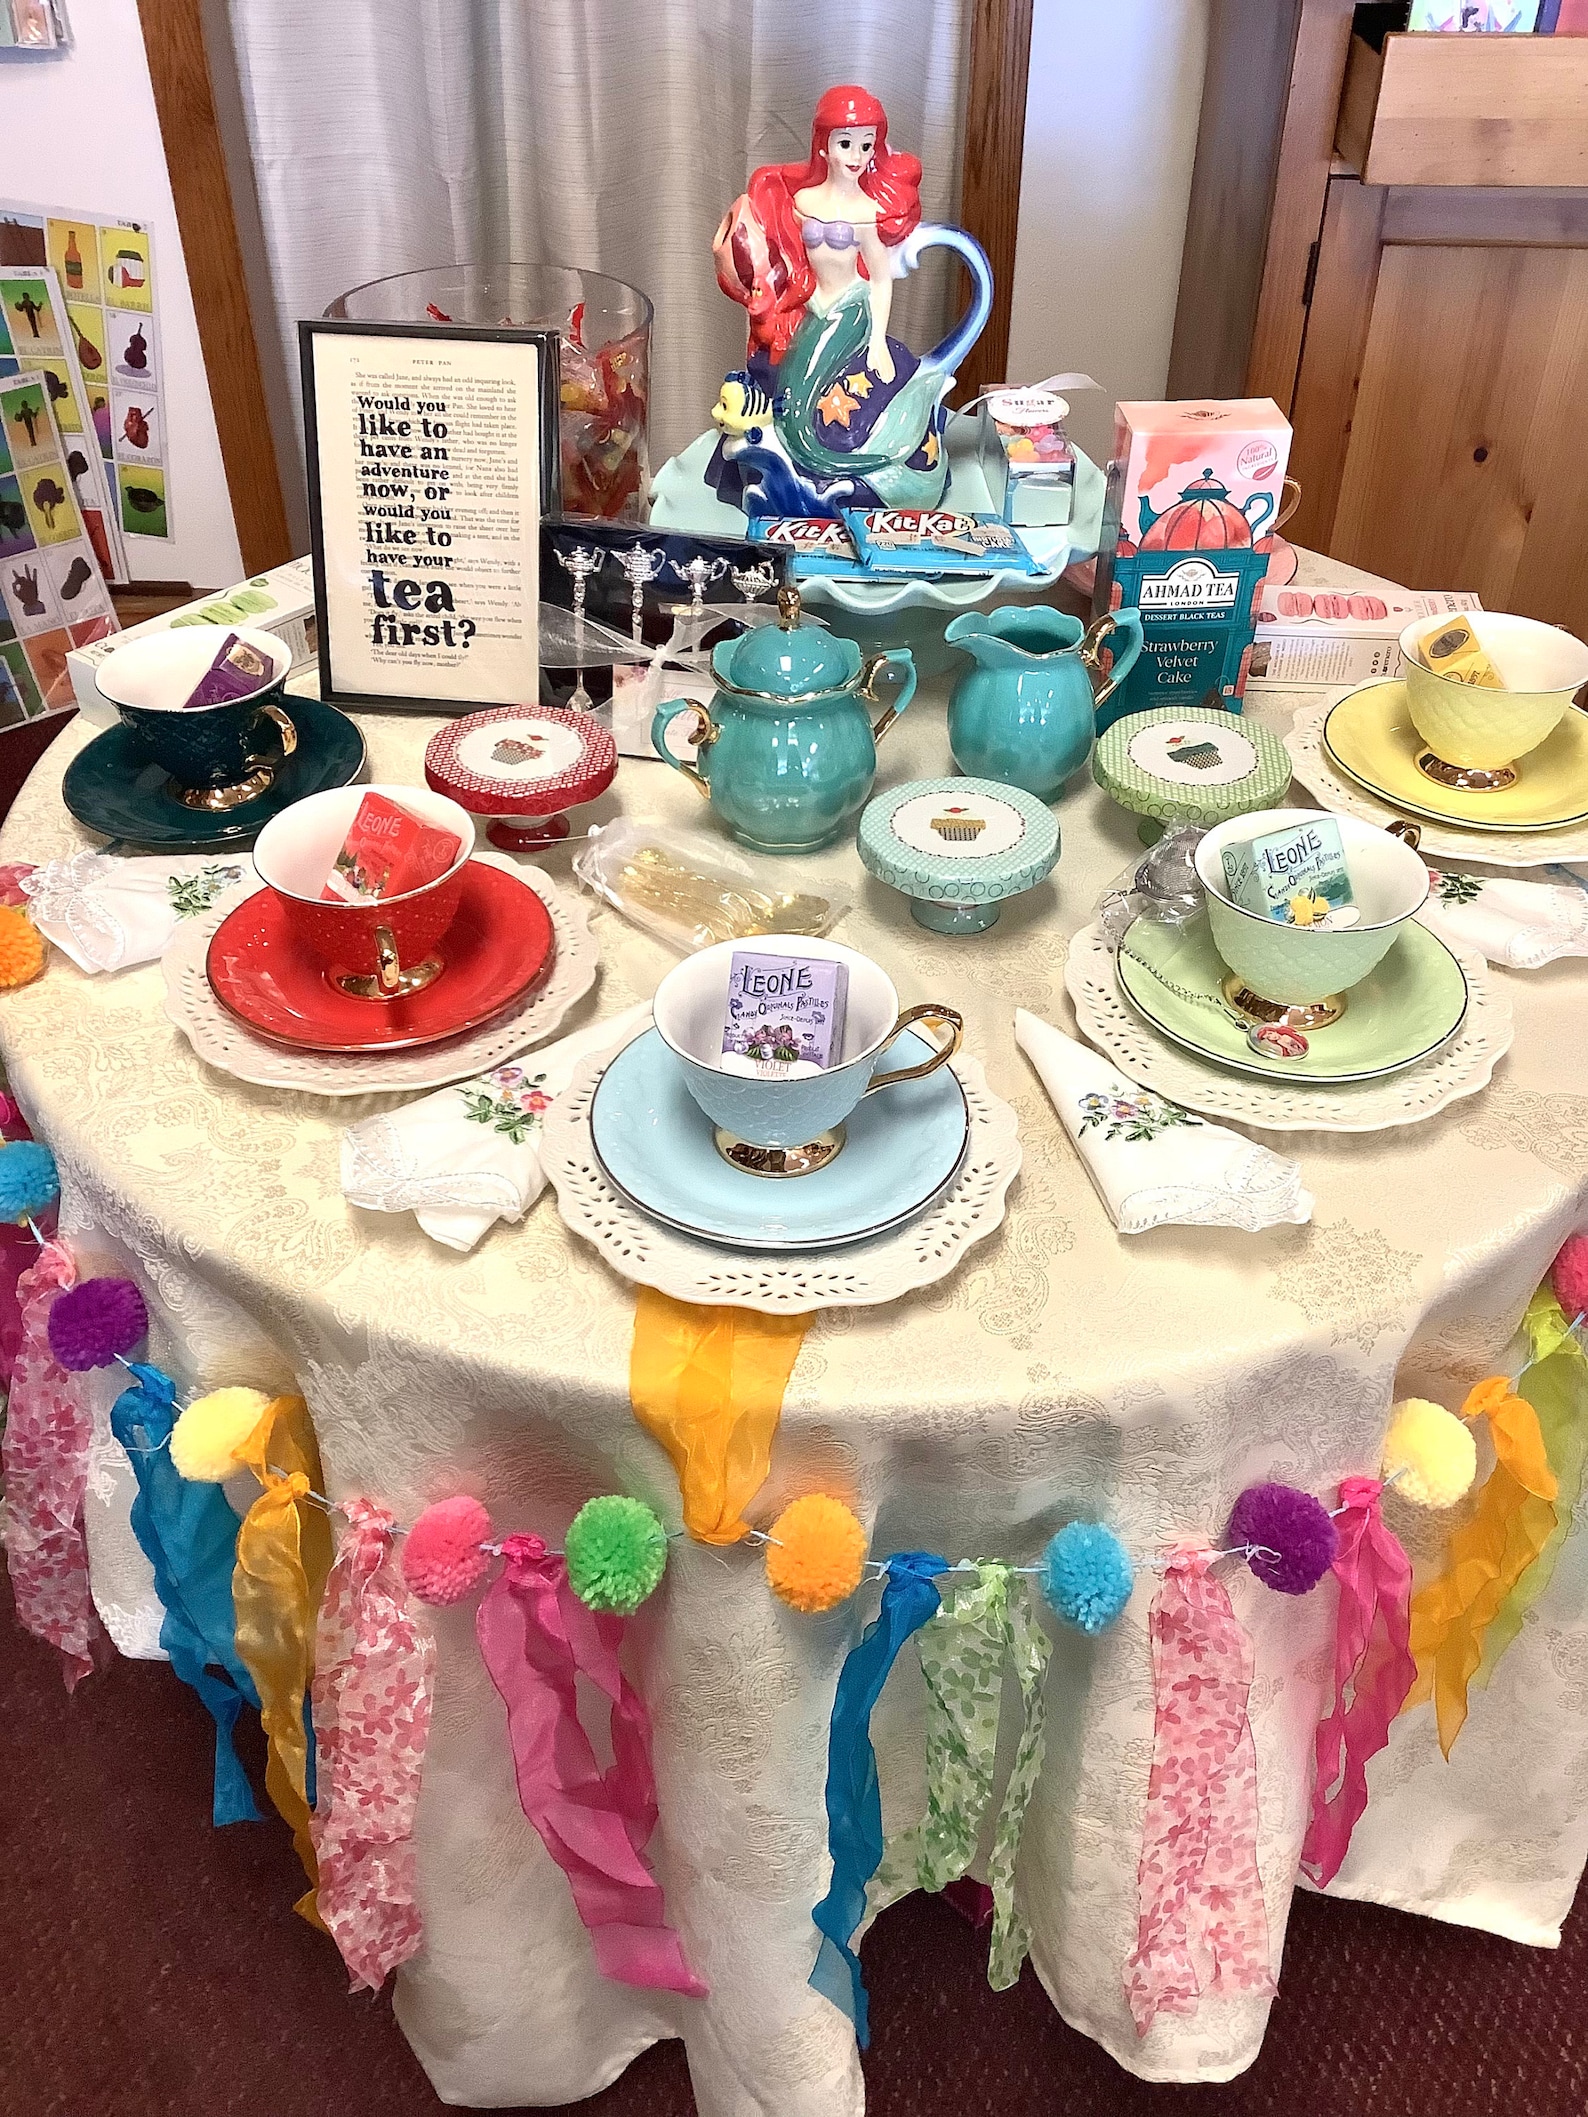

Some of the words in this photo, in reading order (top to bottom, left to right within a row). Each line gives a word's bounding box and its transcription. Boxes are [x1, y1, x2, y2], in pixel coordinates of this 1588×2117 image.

[358, 396, 410, 410] Would
[417, 402, 445, 414] you
[358, 414, 410, 436] like
[421, 419, 447, 438] to
[360, 439, 412, 458] have
[421, 447, 448, 460] an
[1240, 447, 1272, 466] Natural
[362, 463, 449, 479] adventure
[363, 484, 414, 502] now,
[425, 487, 449, 500] or
[364, 505, 414, 518] would
[421, 510, 451, 521] you
[771, 520, 851, 543] KitK
[871, 511, 973, 536] KitKat
[365, 522, 416, 544] like
[426, 527, 451, 546] to
[367, 549, 407, 564] have
[413, 556, 453, 567] your
[369, 570, 455, 613] tea
[1143, 583, 1202, 598] AHMAD
[1206, 583, 1233, 596] TEA
[1180, 612, 1204, 620] BLACK
[371, 614, 475, 648] first?
[1141, 639, 1219, 654] Strawberry
[1157, 656, 1199, 668] Velvet
[1158, 671, 1192, 683] Cake
[357, 801, 403, 837] LEONE
[1264, 829, 1323, 873] LEONE
[1315, 852, 1341, 871] PASTILLES
[740, 965, 813, 998] LEONE
[730, 1007, 757, 1020] CANDY
[758, 1002, 794, 1015] ORIGINALS
[796, 996, 829, 1012] PASTILLES
[754, 1059, 792, 1073] VIOLET
